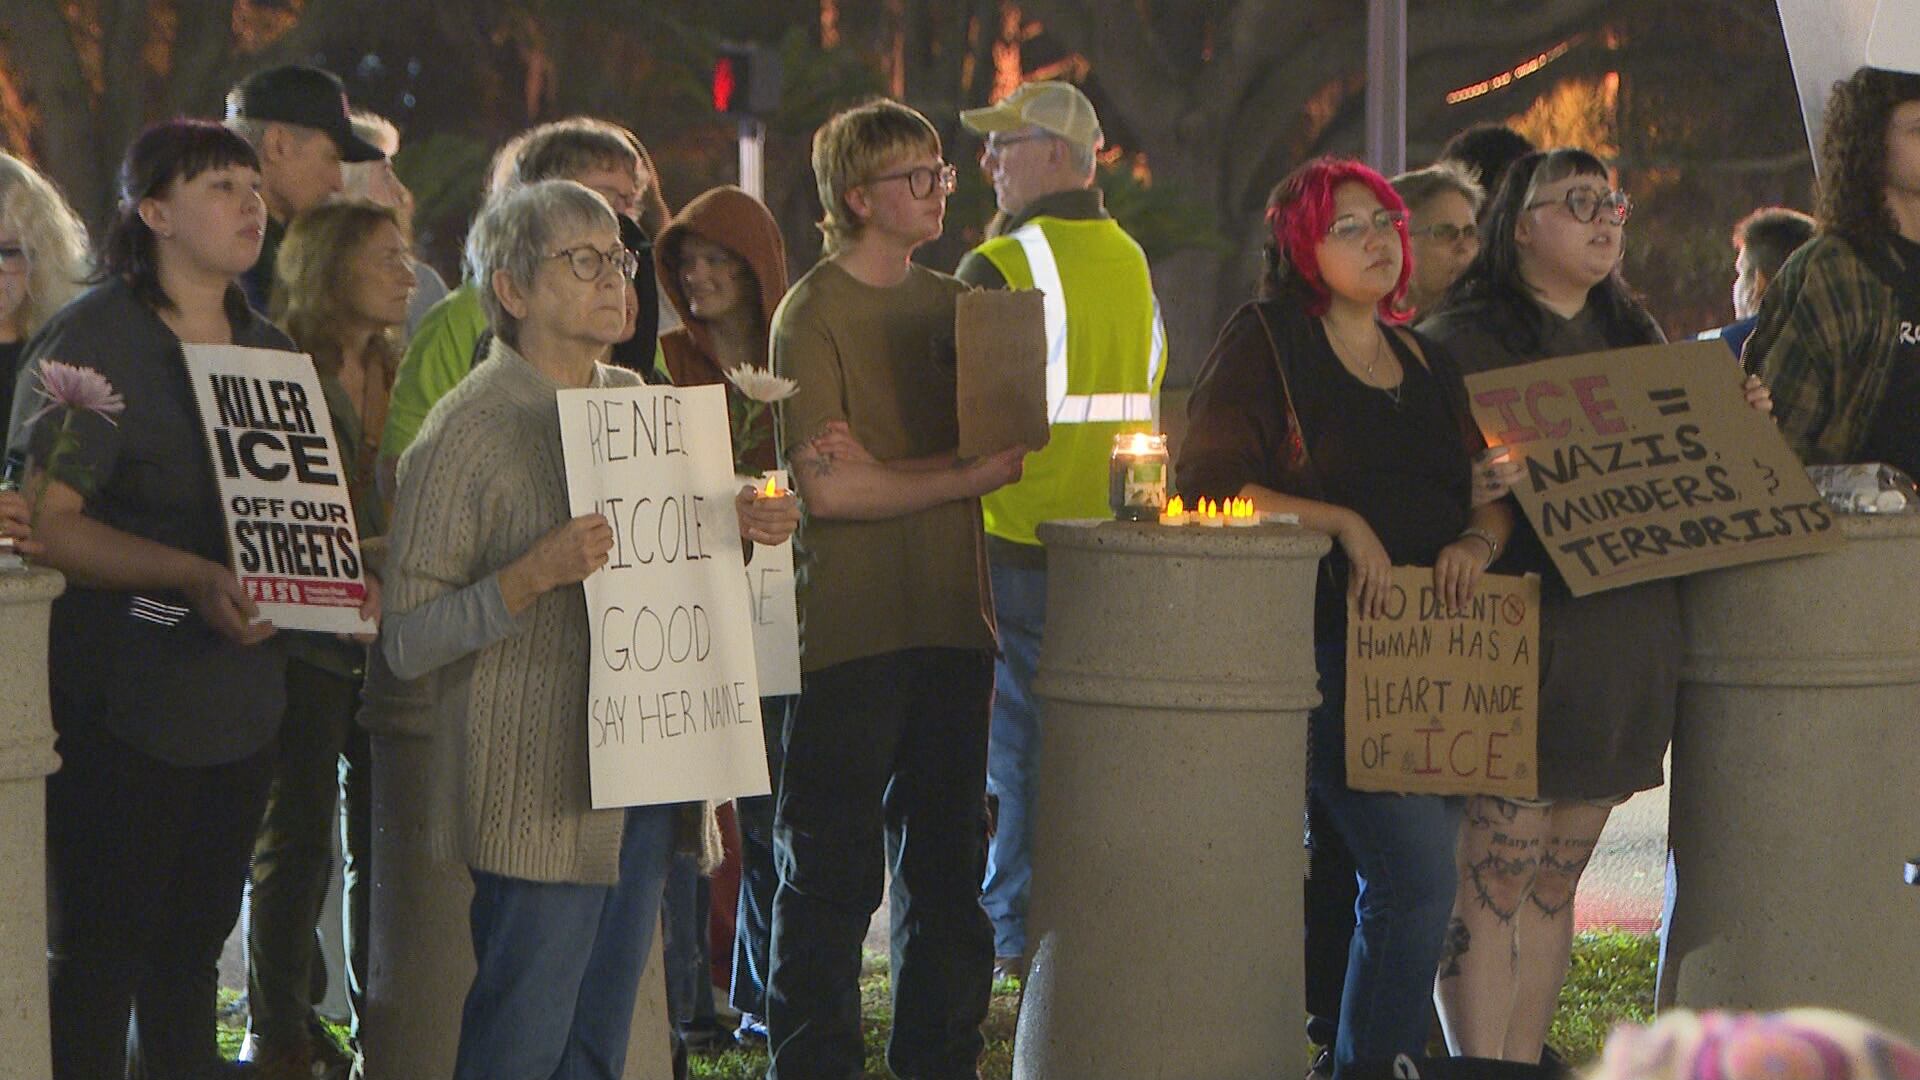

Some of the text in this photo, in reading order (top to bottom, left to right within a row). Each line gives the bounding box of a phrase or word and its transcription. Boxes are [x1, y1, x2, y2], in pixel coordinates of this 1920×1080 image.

[209, 373, 316, 434] KILLER
[213, 427, 338, 486] ICE
[231, 496, 348, 524] OFF OUR
[235, 520, 359, 580] STREETS
[1560, 503, 1832, 577] TERRORISTS
[601, 605, 711, 672] GOOD
[1449, 623, 1500, 661] HAS
[1512, 635, 1529, 664] A
[592, 682, 753, 748] SAY HER NAME
[1364, 676, 1524, 720] HEART MADE
[1361, 728, 1509, 779] OF ICE
